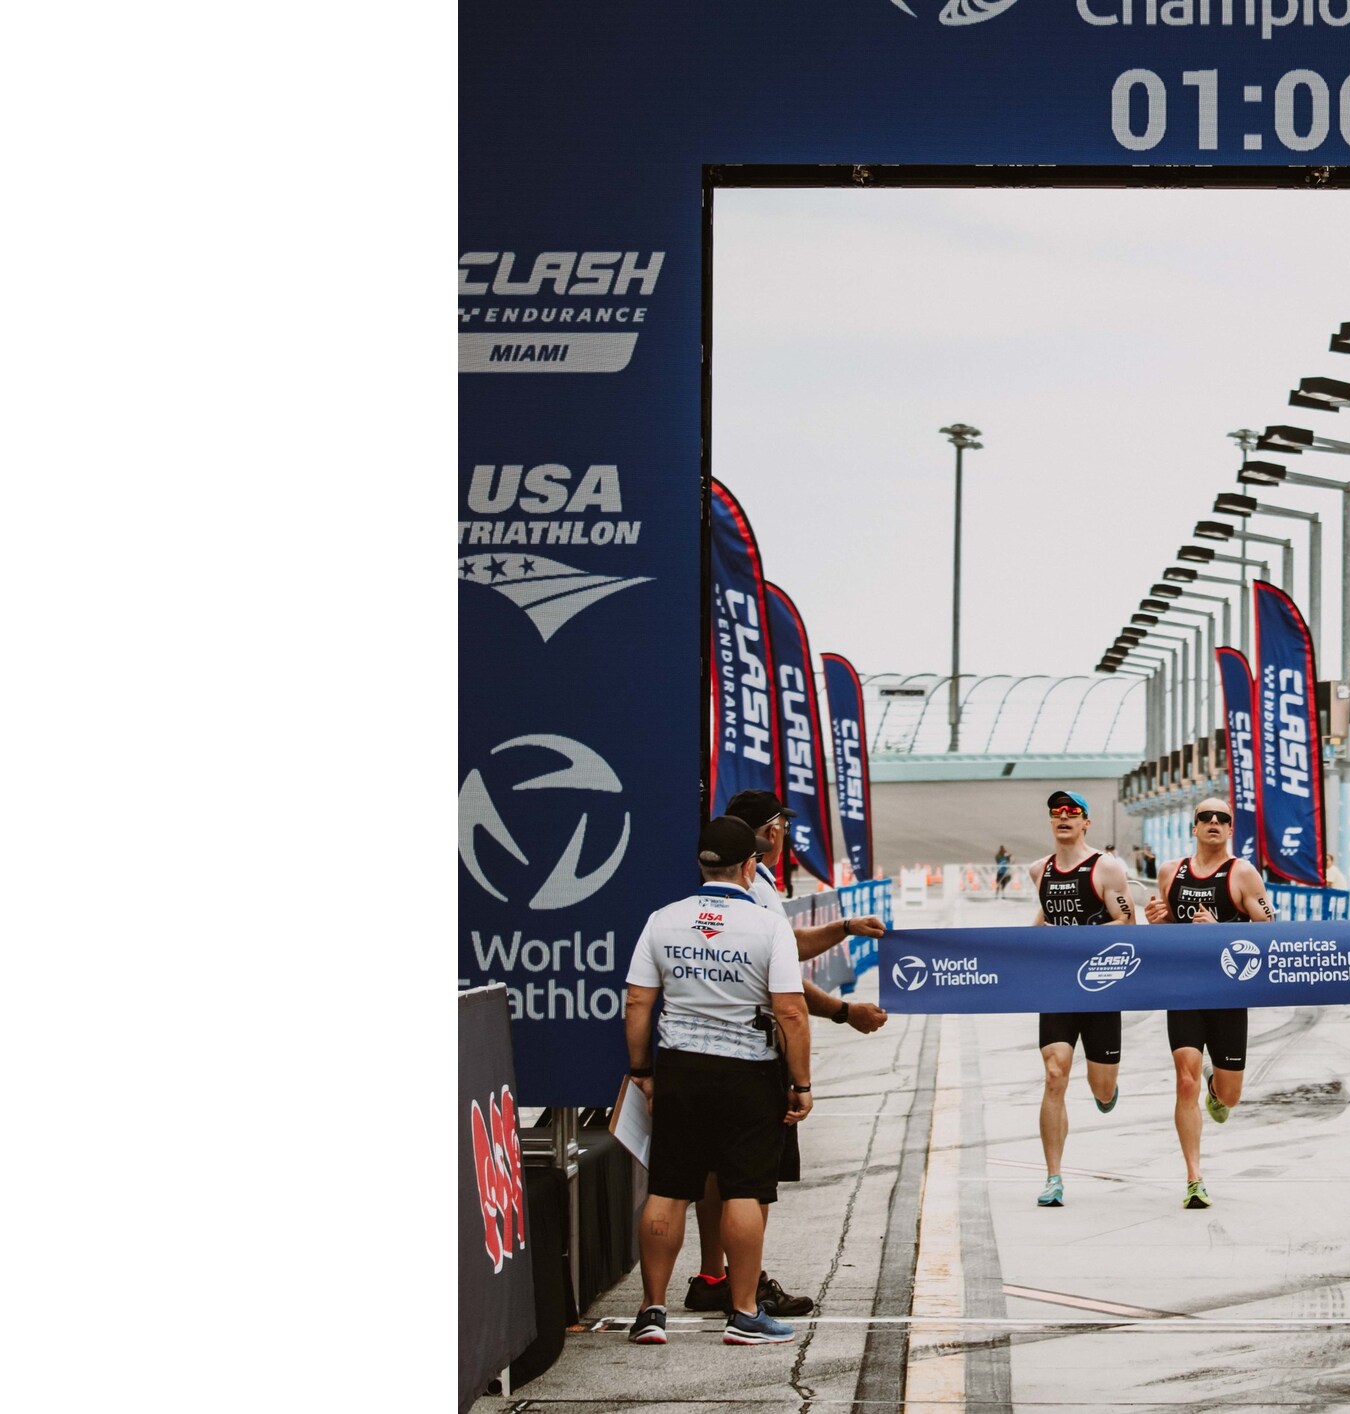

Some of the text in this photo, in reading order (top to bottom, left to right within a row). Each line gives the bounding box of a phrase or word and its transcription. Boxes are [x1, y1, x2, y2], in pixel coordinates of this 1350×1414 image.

[458, 251, 666, 296] CLASH
[484, 307, 648, 323] ENDURANCE
[489, 344, 569, 362] MIAMI
[467, 463, 623, 514] USA
[458, 520, 642, 546] TRIATHLON
[717, 617, 737, 754] ENDURANCE
[725, 589, 771, 766] CLASH
[779, 664, 816, 796] CLASH
[1264, 689, 1276, 788] ENDURANCE
[1279, 668, 1310, 799] CLASH
[841, 718, 865, 821] CLASH
[1230, 731, 1243, 810] ENDURANCE
[1235, 711, 1257, 813] CLASH
[1182, 889, 1213, 898] BUBBA
[1045, 898, 1084, 913] GUIDE
[1176, 904, 1219, 920] CON
[698, 912, 723, 922] USA
[1053, 915, 1080, 925] USA
[470, 930, 615, 972] World
[663, 945, 753, 965] TECHNICAL
[1268, 937, 1337, 953] Americas
[932, 957, 978, 972] World
[1090, 955, 1130, 967] CLASH
[672, 965, 744, 983] OFFICIAL
[932, 970, 999, 987] Triathlon
